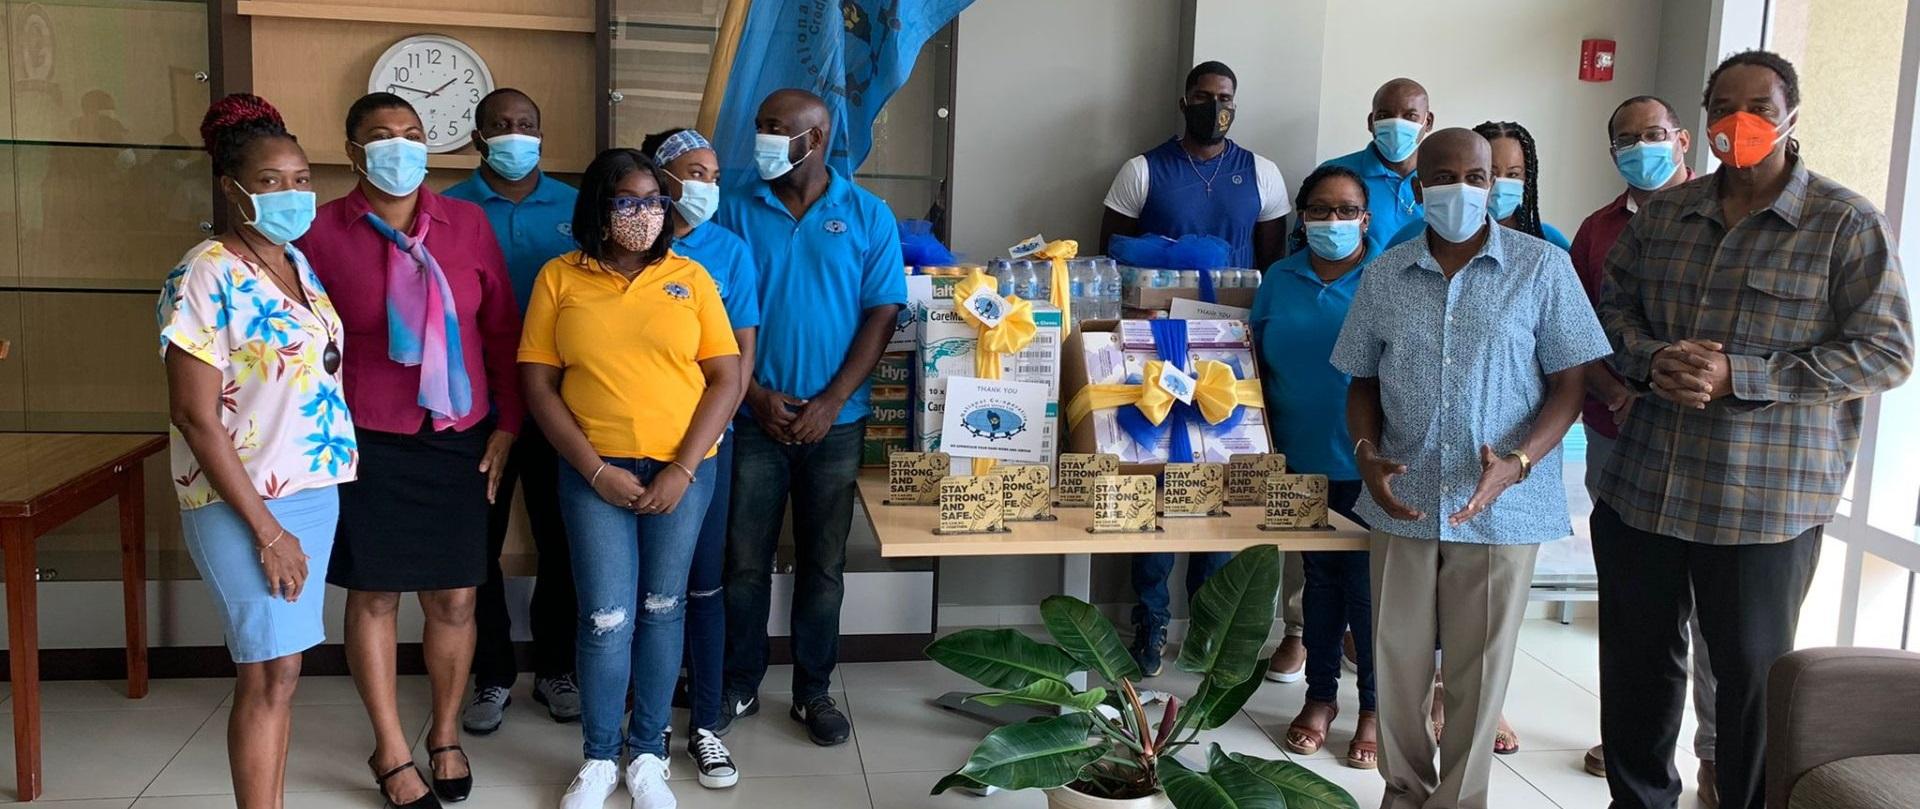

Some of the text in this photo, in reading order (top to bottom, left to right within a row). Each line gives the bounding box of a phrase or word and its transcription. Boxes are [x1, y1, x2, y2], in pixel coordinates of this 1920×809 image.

[408, 53, 420, 68] 11
[426, 49, 442, 65] 12
[451, 55, 457, 70] 1
[394, 66, 410, 83] 10
[464, 69, 474, 84] 2
[469, 88, 480, 104] 3
[461, 108, 472, 122] 4
[427, 125, 438, 140] 6
[447, 121, 458, 136] 5
[977, 385, 1018, 395] THANK YOU
[891, 460, 917, 468] STAY
[1230, 462, 1255, 470] STAY
[1002, 474, 1016, 482] AY
[1165, 471, 1190, 479] STAY
[1003, 482, 1033, 491] RONG
[1060, 478, 1083, 486] AND
[1165, 479, 1207, 488] STRONG
[1230, 478, 1252, 486] AND
[1267, 482, 1293, 491] STAY
[941, 485, 968, 494] STAY
[1095, 484, 1122, 493] STAY
[1165, 488, 1187, 496] AND
[941, 493, 986, 503] STRONG
[1095, 492, 1139, 501] STRONG
[942, 503, 965, 511] AND
[1005, 500, 1020, 508] FE.
[1267, 500, 1290, 508] AND
